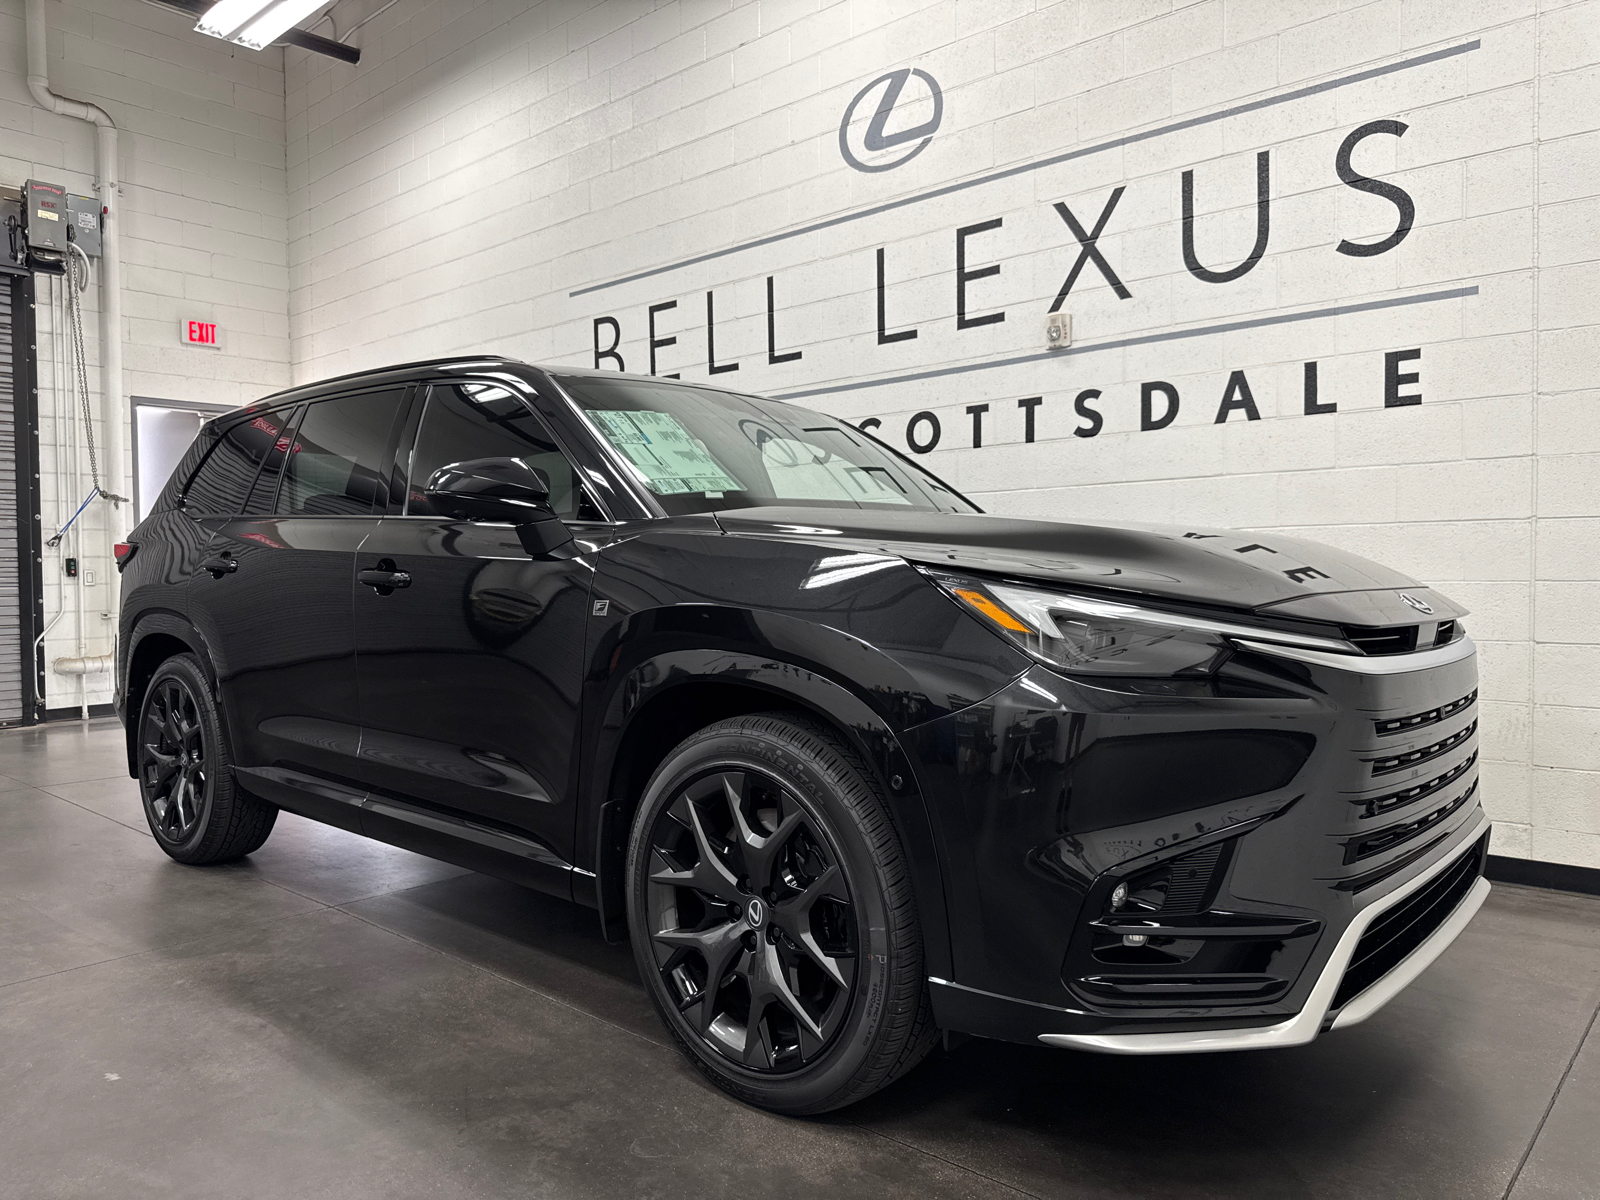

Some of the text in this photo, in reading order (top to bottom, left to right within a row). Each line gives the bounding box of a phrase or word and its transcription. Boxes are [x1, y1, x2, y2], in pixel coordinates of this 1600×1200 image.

[593, 119, 1415, 379] BELL LEXUS
[188, 320, 217, 344] EXIT
[716, 743, 825, 805] CONTINENTAL
